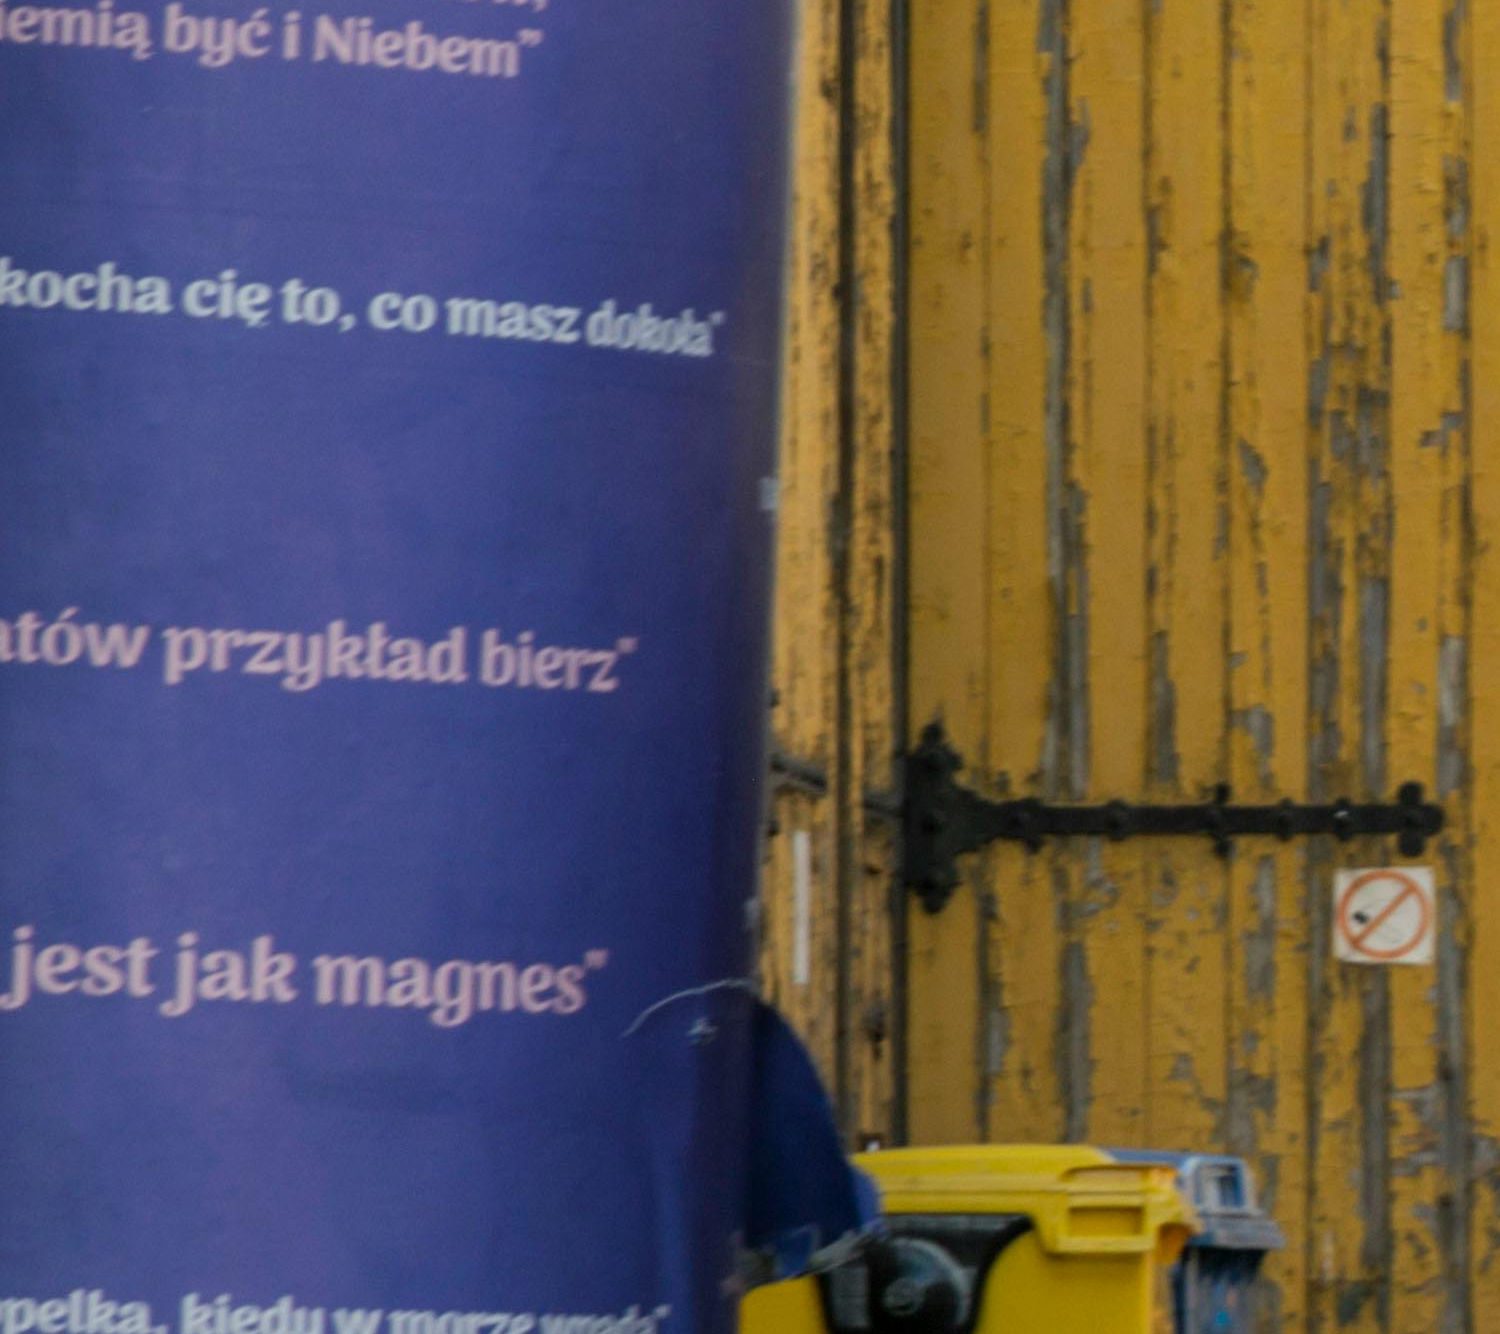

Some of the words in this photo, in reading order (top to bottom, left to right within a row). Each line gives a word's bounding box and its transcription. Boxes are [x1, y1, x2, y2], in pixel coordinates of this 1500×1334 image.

[164, 0, 271, 67] być
[282, 9, 302, 59] i
[182, 268, 270, 327] cię
[280, 275, 356, 332] to,
[367, 293, 437, 333] co
[446, 296, 582, 345] masz
[161, 620, 468, 692] przykład
[0, 923, 160, 1010] jest
[158, 931, 299, 1017] jak
